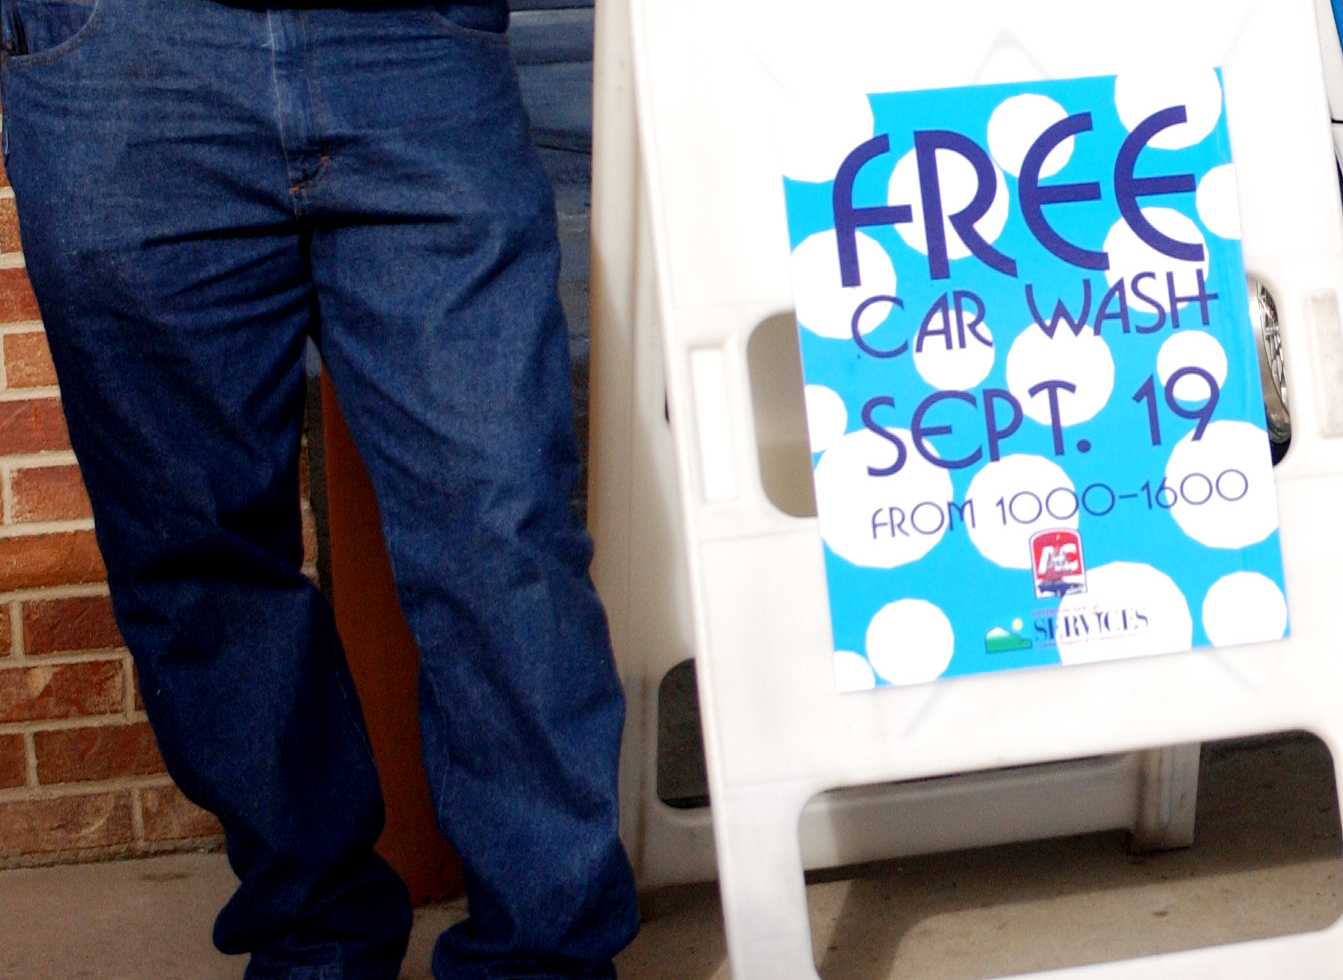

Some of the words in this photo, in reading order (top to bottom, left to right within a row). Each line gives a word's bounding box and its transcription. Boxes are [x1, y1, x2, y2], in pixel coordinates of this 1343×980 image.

[832, 104, 1205, 288] FREE
[851, 289, 993, 359] CAR
[1025, 268, 1219, 339] WASH
[861, 380, 1091, 477] SEPT.
[1132, 366, 1219, 446] 19
[871, 499, 975, 540] FROM
[996, 469, 1248, 526] 1000-1600
[1034, 607, 1149, 642] SERVICES
